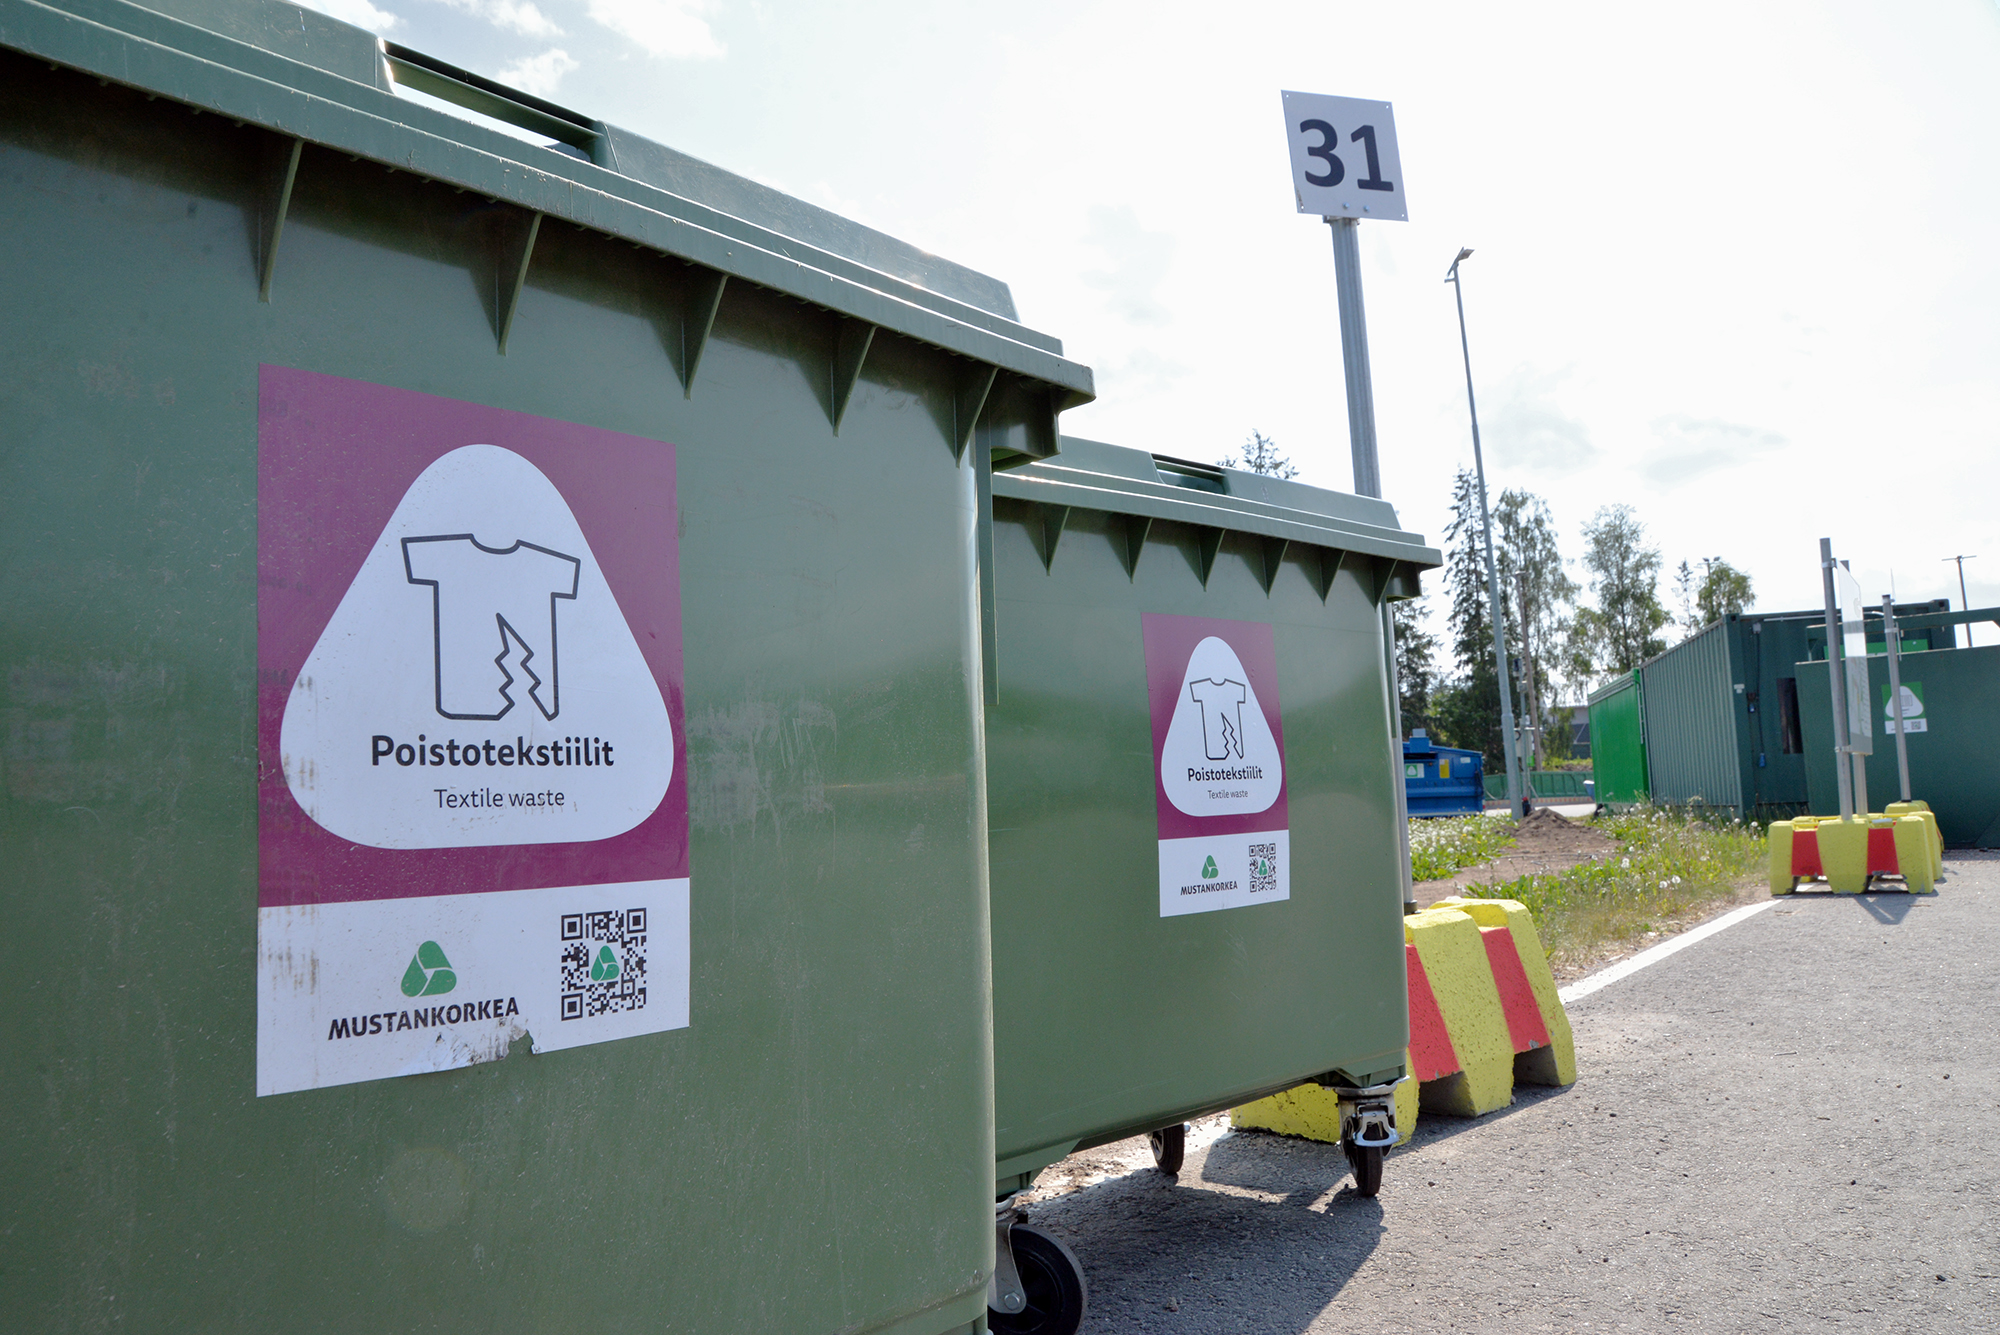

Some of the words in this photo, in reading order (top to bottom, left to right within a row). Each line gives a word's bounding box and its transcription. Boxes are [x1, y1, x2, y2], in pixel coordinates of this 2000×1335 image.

[1299, 118, 1394, 192] 31
[371, 734, 615, 767] Poistotekstiilit
[1187, 766, 1263, 782] Poistotekstiilit
[433, 787, 504, 809] Textile
[509, 788, 565, 807] waste
[1207, 789, 1230, 800] Textile
[1230, 789, 1249, 799] waste
[1180, 880, 1238, 896] MUSTANKORKEA
[327, 997, 520, 1041] MUSTANKORKEA
